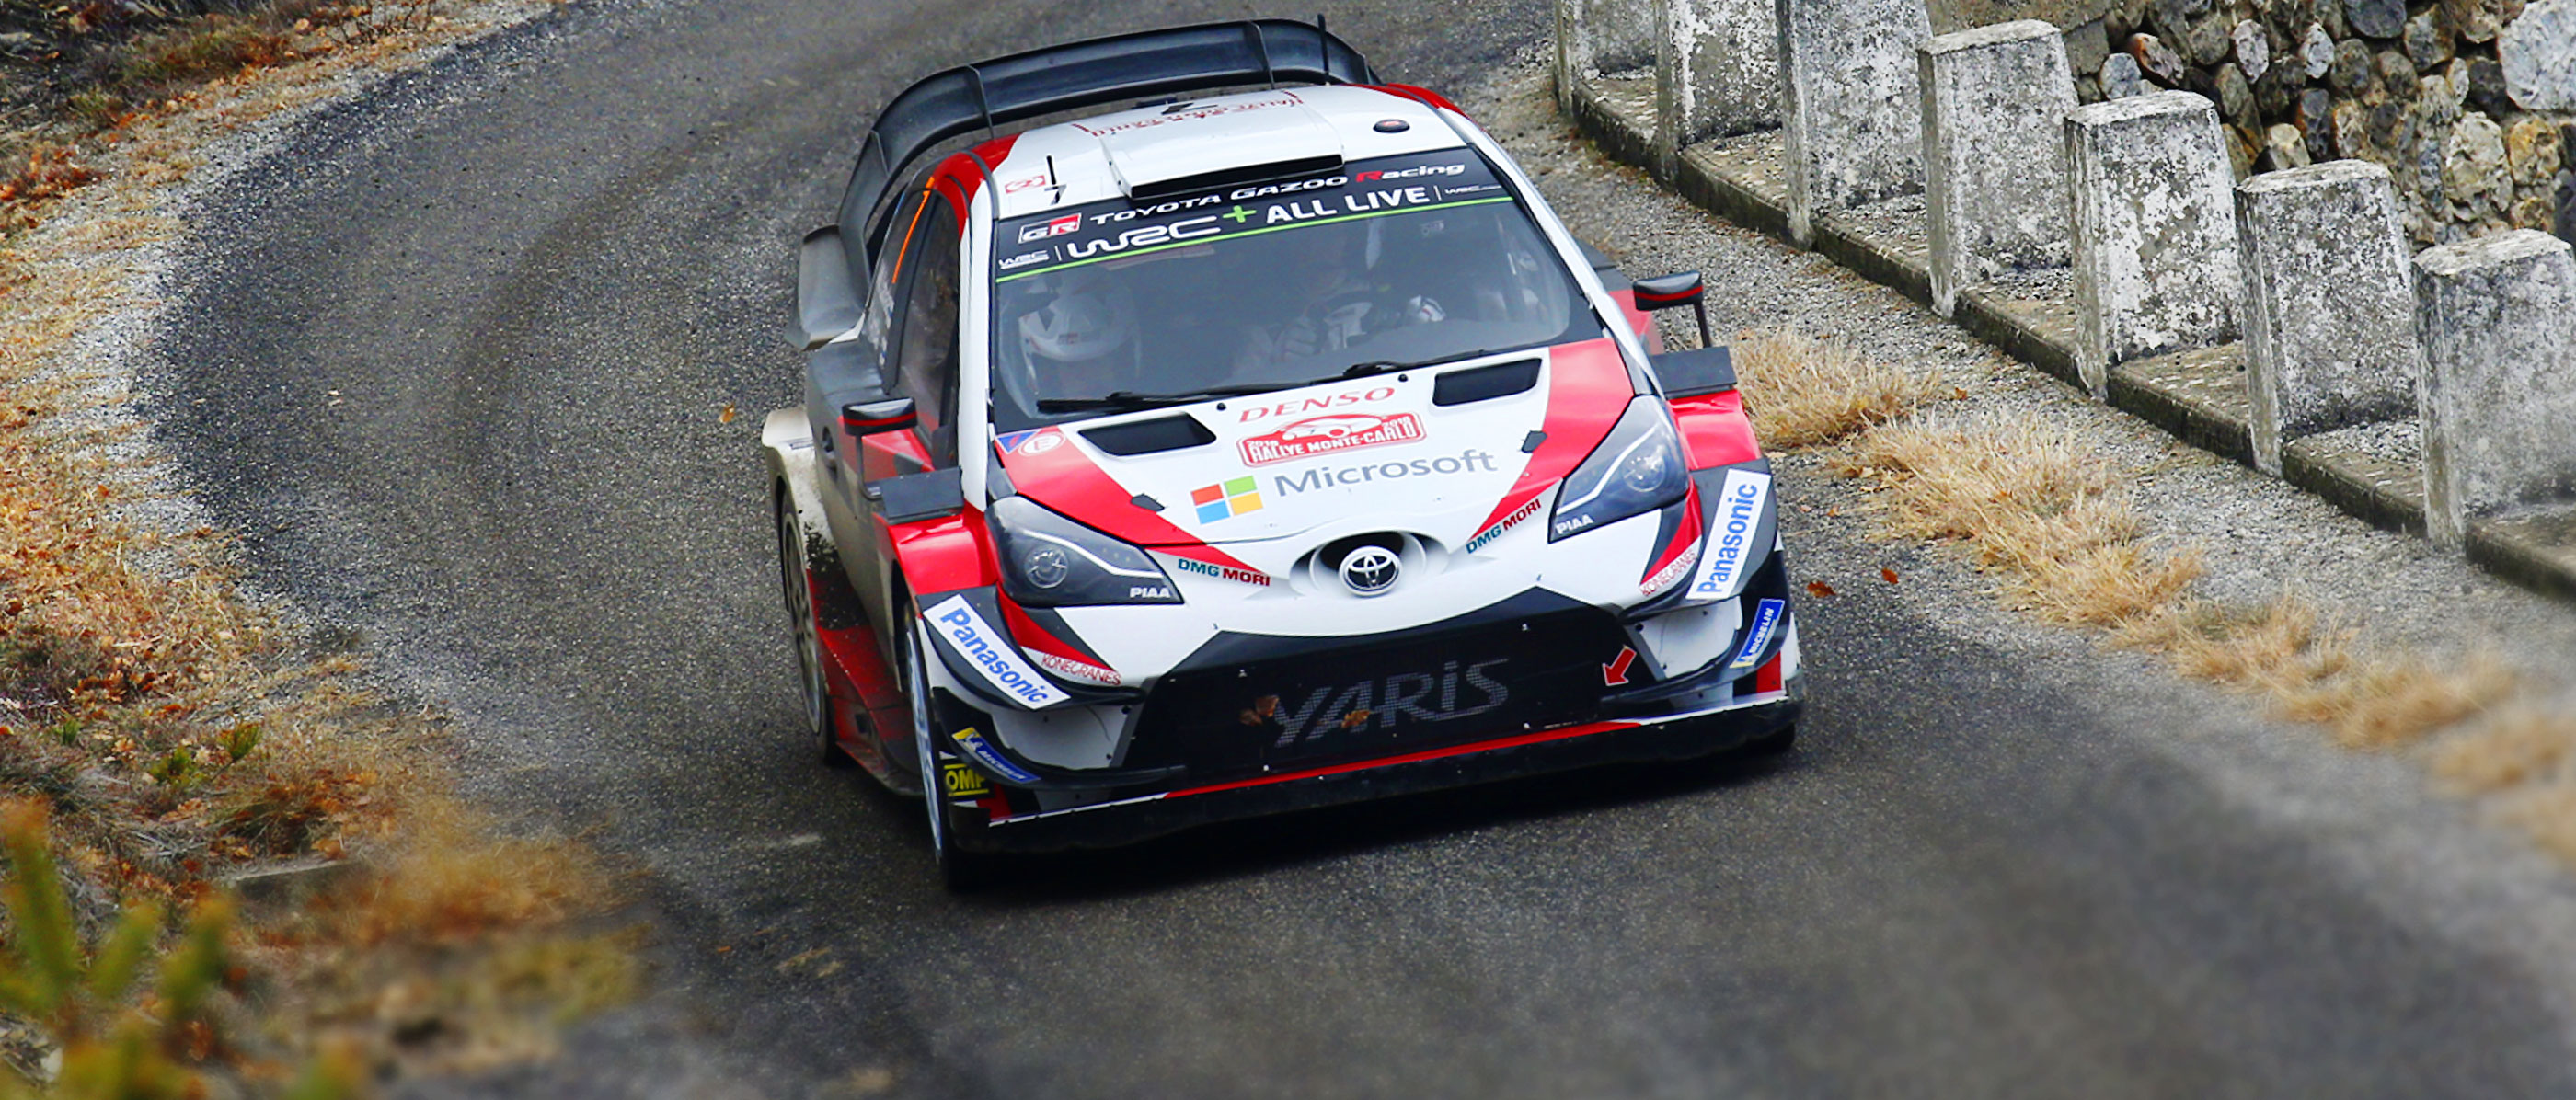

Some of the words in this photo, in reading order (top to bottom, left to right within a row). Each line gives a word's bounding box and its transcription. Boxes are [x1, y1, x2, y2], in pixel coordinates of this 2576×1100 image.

[1089, 195, 1221, 225] TOYOTA
[1230, 175, 1349, 201] GAZOO
[1355, 163, 1466, 183] Racing
[1266, 199, 1338, 224] ALL
[1344, 186, 1430, 212] LIVE
[1020, 220, 1079, 242] GR
[1239, 387, 1396, 423] DENSO
[1248, 443, 1305, 463] RALLYE
[1306, 421, 1418, 453] MONTE-CARLO
[1273, 449, 1499, 497] Microsoft
[1466, 524, 1502, 554] DMG
[1502, 498, 1542, 531] MORI
[1555, 513, 1594, 535] PIAA
[1696, 483, 1758, 594] Panasonic
[1178, 558, 1220, 578] DMG
[1222, 567, 1271, 587] MORI
[1129, 587, 1171, 599] PIAA
[939, 606, 1049, 704] Panasonic
[1041, 653, 1121, 686] KONECRANES
